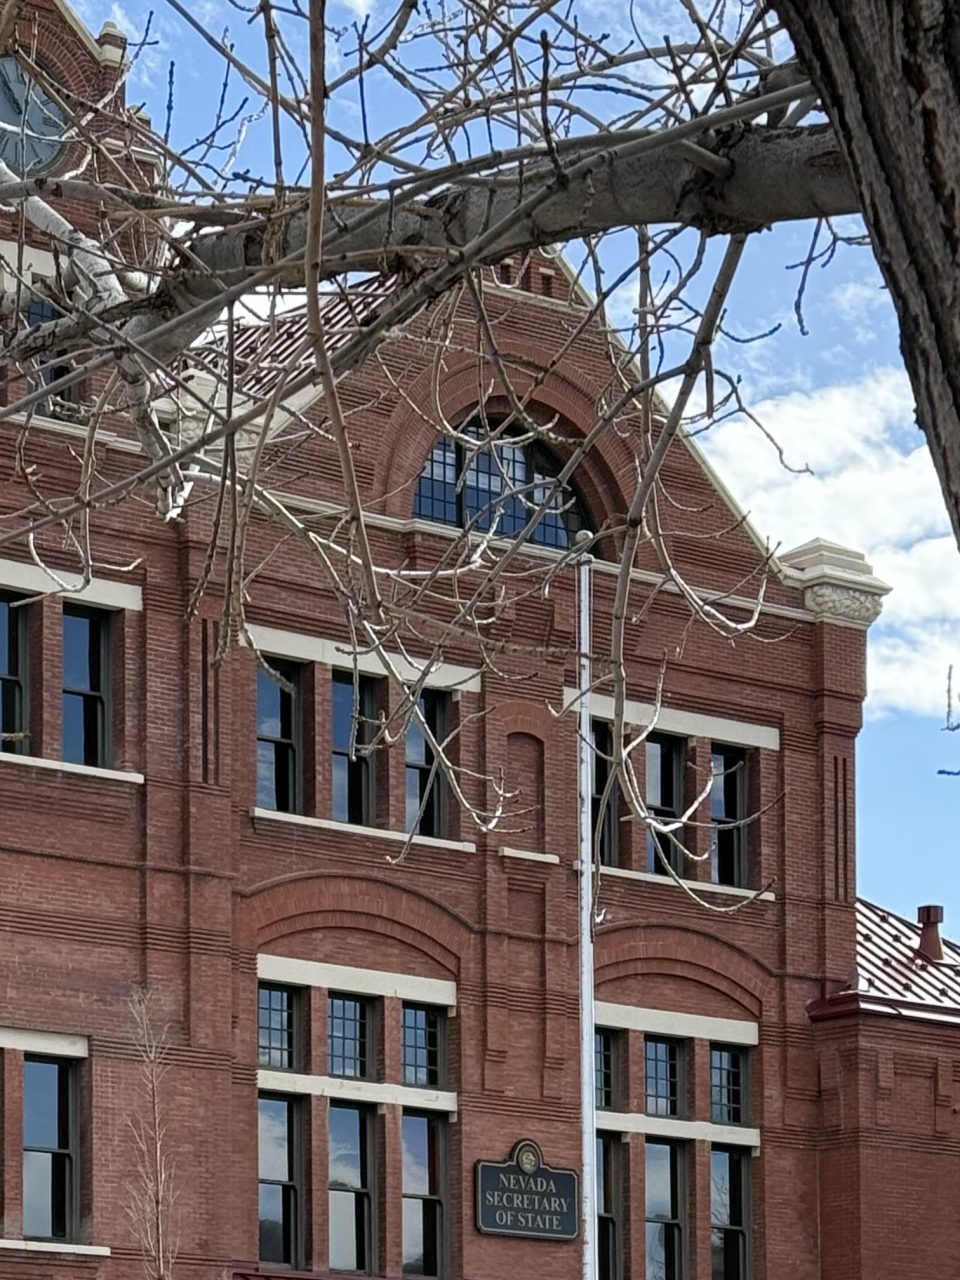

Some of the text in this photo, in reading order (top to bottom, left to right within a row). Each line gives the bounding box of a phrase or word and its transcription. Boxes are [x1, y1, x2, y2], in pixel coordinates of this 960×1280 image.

[499, 1173, 556, 1193] NEVADA
[485, 1190, 570, 1212] SECRETARY
[495, 1210, 562, 1230] OF STATE
